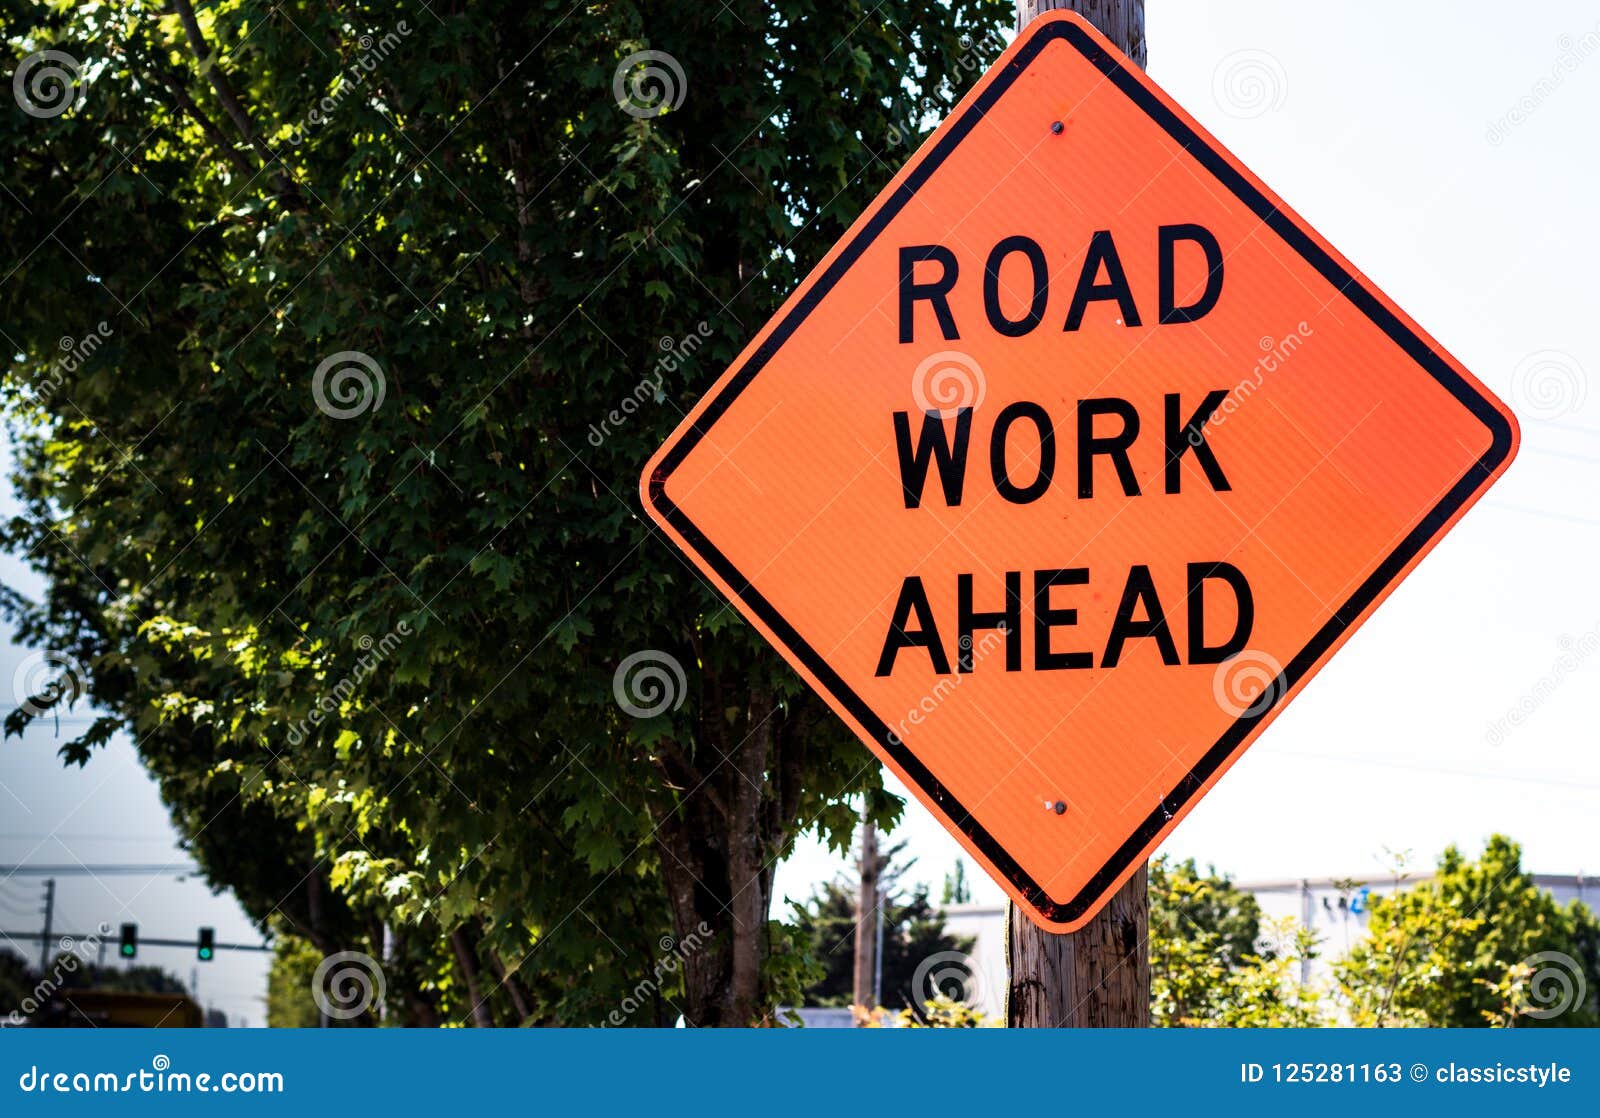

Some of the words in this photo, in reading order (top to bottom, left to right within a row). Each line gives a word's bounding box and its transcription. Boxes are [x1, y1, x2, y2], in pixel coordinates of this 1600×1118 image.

[899, 223, 1224, 343] ROAD
[893, 390, 1231, 508] WORK
[875, 561, 1254, 677] AHEAD
